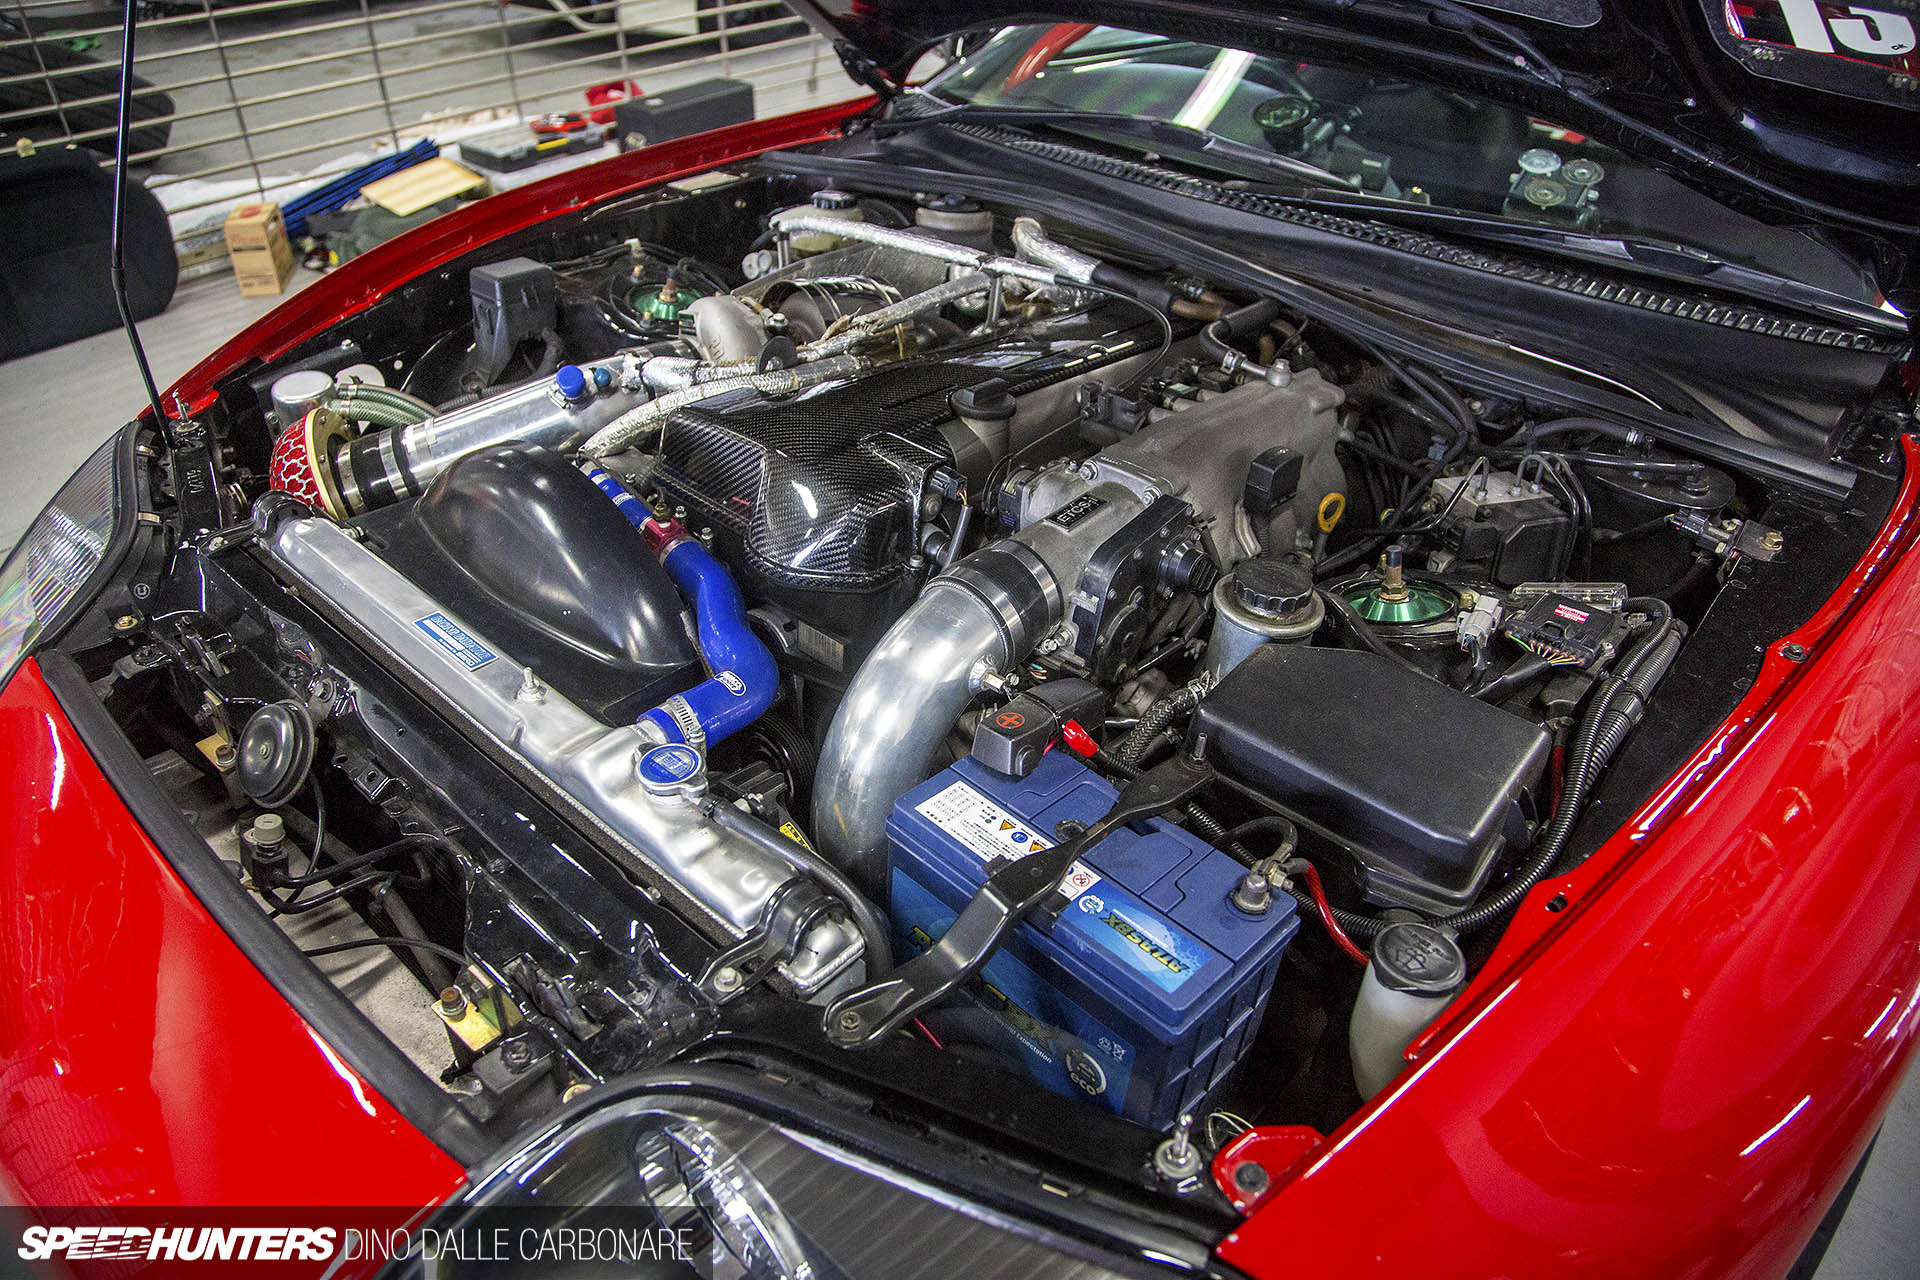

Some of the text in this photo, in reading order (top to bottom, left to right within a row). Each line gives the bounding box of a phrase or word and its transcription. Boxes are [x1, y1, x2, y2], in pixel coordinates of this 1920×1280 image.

[1102, 911, 1192, 975] ATLASBX
[1015, 1032, 1053, 1064] Expectation
[1069, 1070, 1098, 1097] eco
